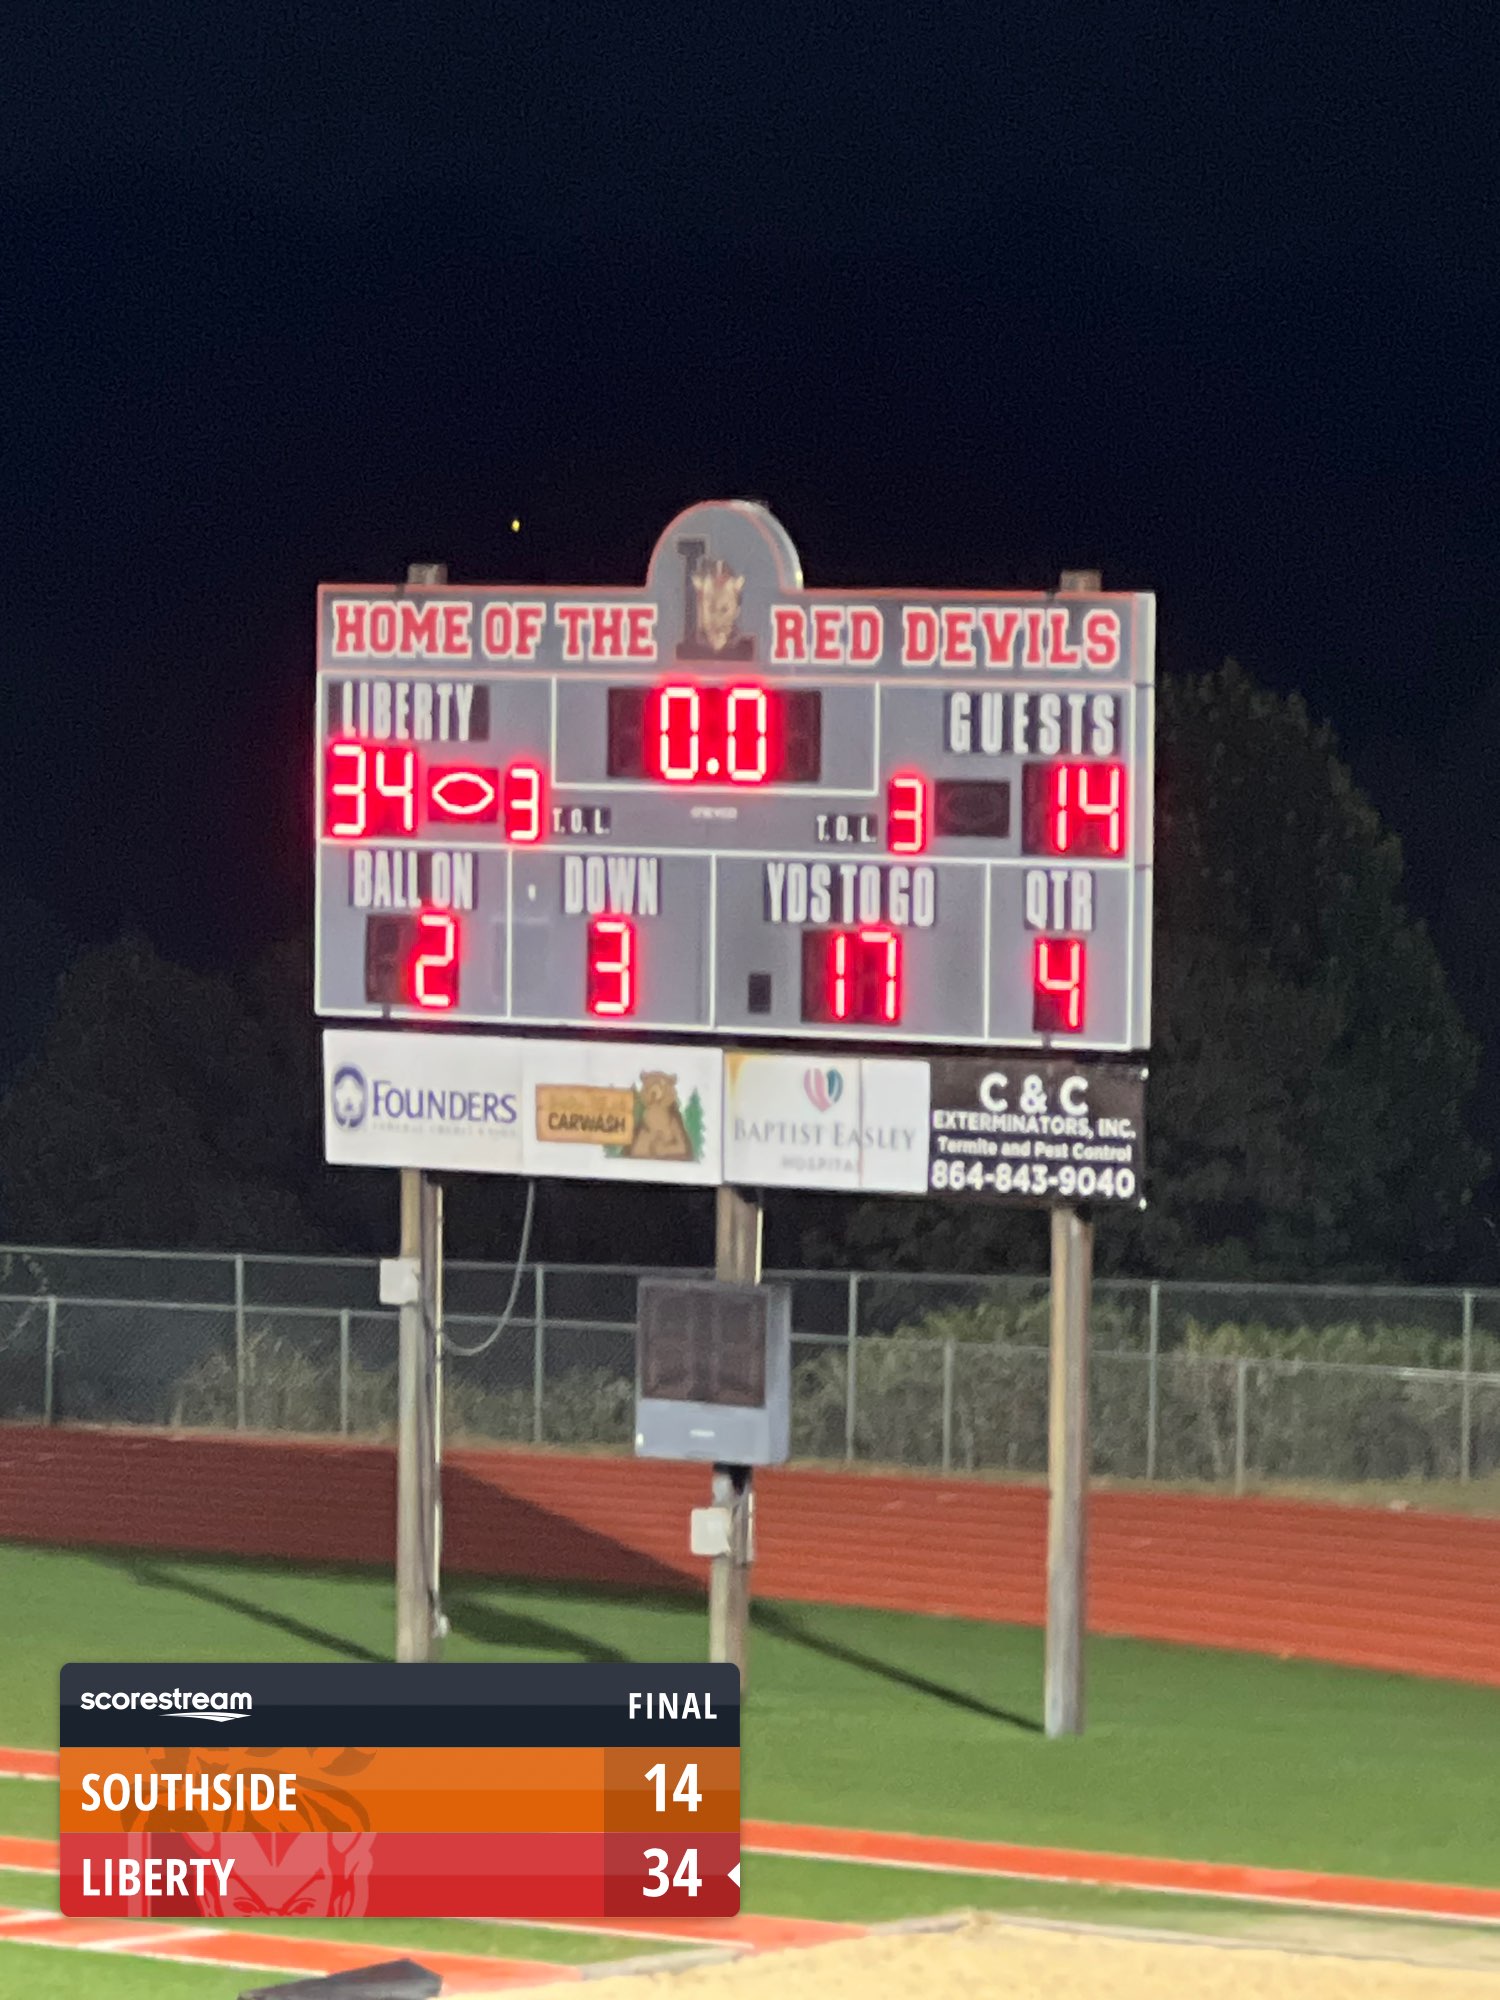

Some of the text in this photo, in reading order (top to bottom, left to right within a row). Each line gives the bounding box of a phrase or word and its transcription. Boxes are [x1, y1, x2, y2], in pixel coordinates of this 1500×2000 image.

[332, 600, 1121, 670] HOME OF THE RED DEVILS
[343, 680, 474, 741] LIBERTY
[660, 687, 767, 781] 0.0
[950, 691, 1115, 755] GUESTS
[332, 743, 415, 836] 34
[510, 768, 540, 842] 3
[893, 778, 923, 852] 3
[1057, 766, 1120, 851] 14
[353, 850, 474, 910] BALL ON
[563, 855, 659, 915] DOWN
[766, 862, 935, 927] YDS TO GO
[1025, 869, 1093, 931] QTR
[415, 914, 455, 1007] 2
[595, 921, 630, 1014] 3
[835, 931, 897, 1021] 17
[1038, 941, 1080, 1028] 4
[932, 1109, 1136, 1139] EXTERMINATORS, INC.
[980, 1072, 1089, 1116] C & C
[931, 1158, 1136, 1199] 864-843-9040
[938, 1135, 1132, 1162] Termite and Pest Control
